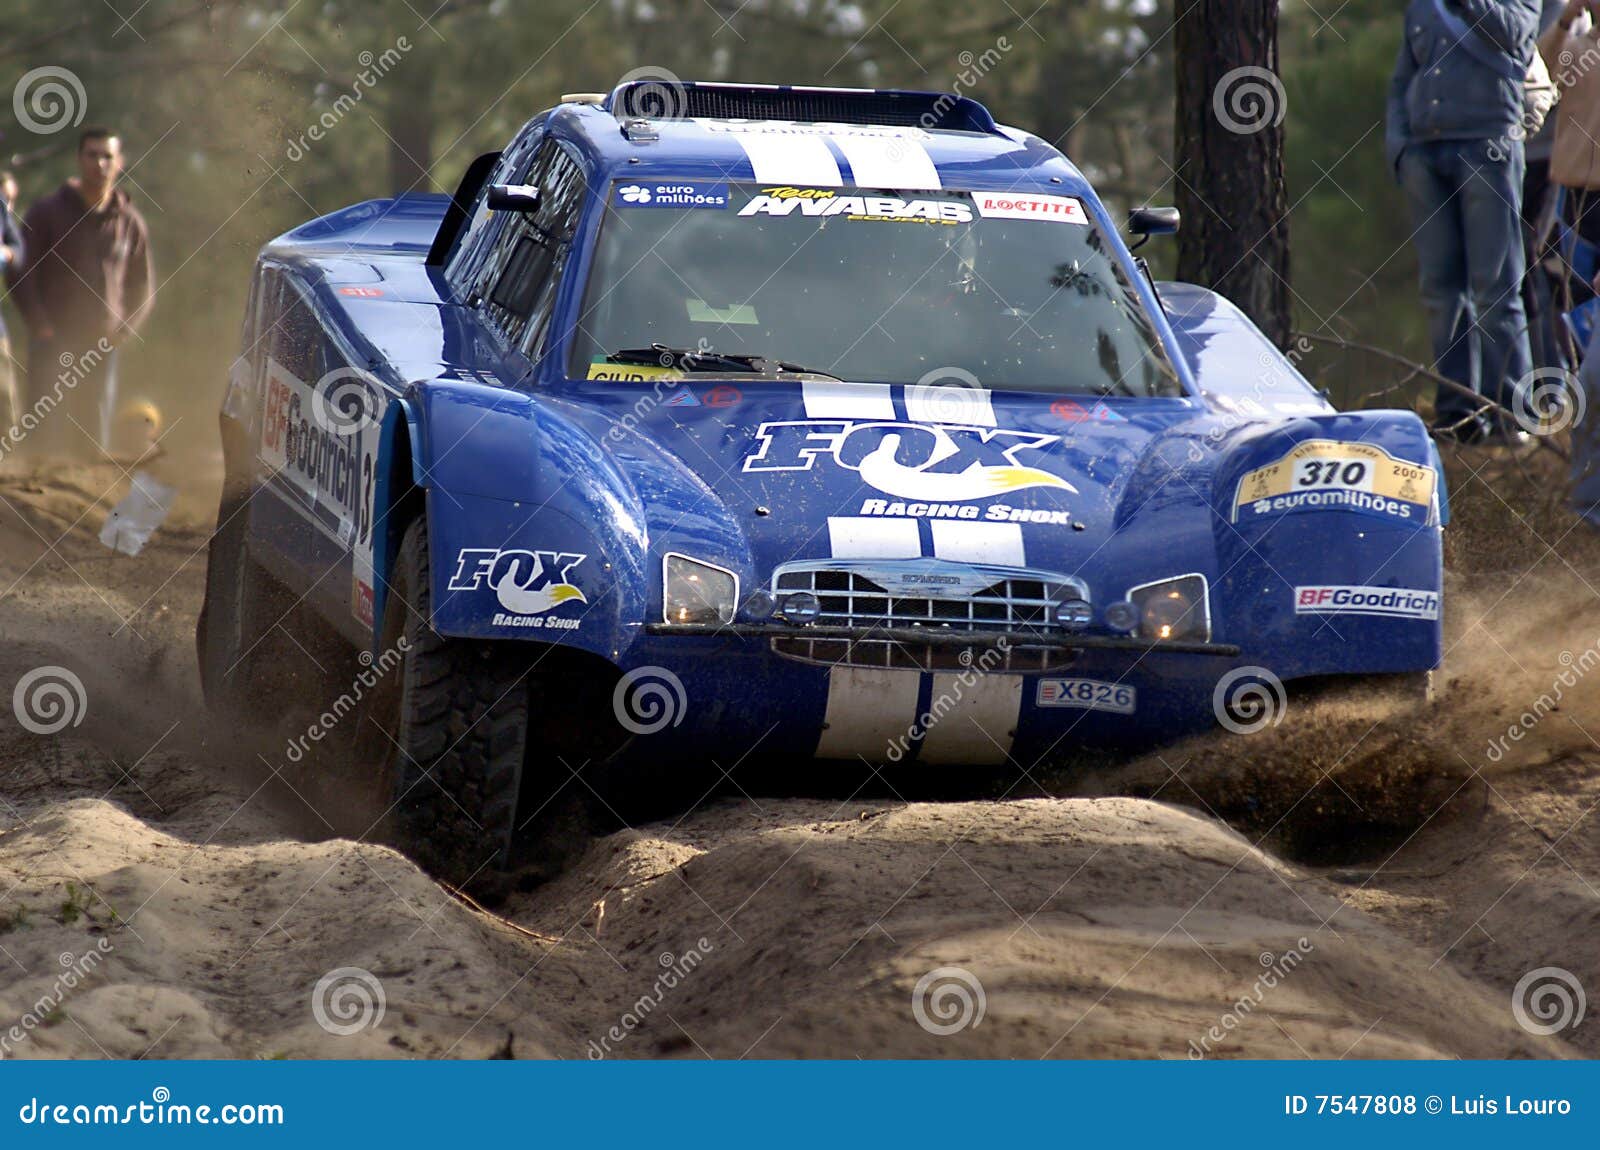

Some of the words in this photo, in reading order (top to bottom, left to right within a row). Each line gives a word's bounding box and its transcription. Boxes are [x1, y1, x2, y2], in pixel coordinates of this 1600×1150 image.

[656, 185, 695, 195] euro
[762, 187, 834, 199] Team
[984, 199, 1076, 216] LOCTITE
[264, 375, 355, 511] BFGoodrich
[742, 420, 1063, 482] FOX
[1299, 461, 1366, 487] 310
[1393, 465, 1425, 480] 2007
[1273, 490, 1411, 518] euromilhões
[448, 548, 588, 598] FOX
[1298, 589, 1437, 612] BFGoodrich
[1058, 681, 1130, 706] X826
